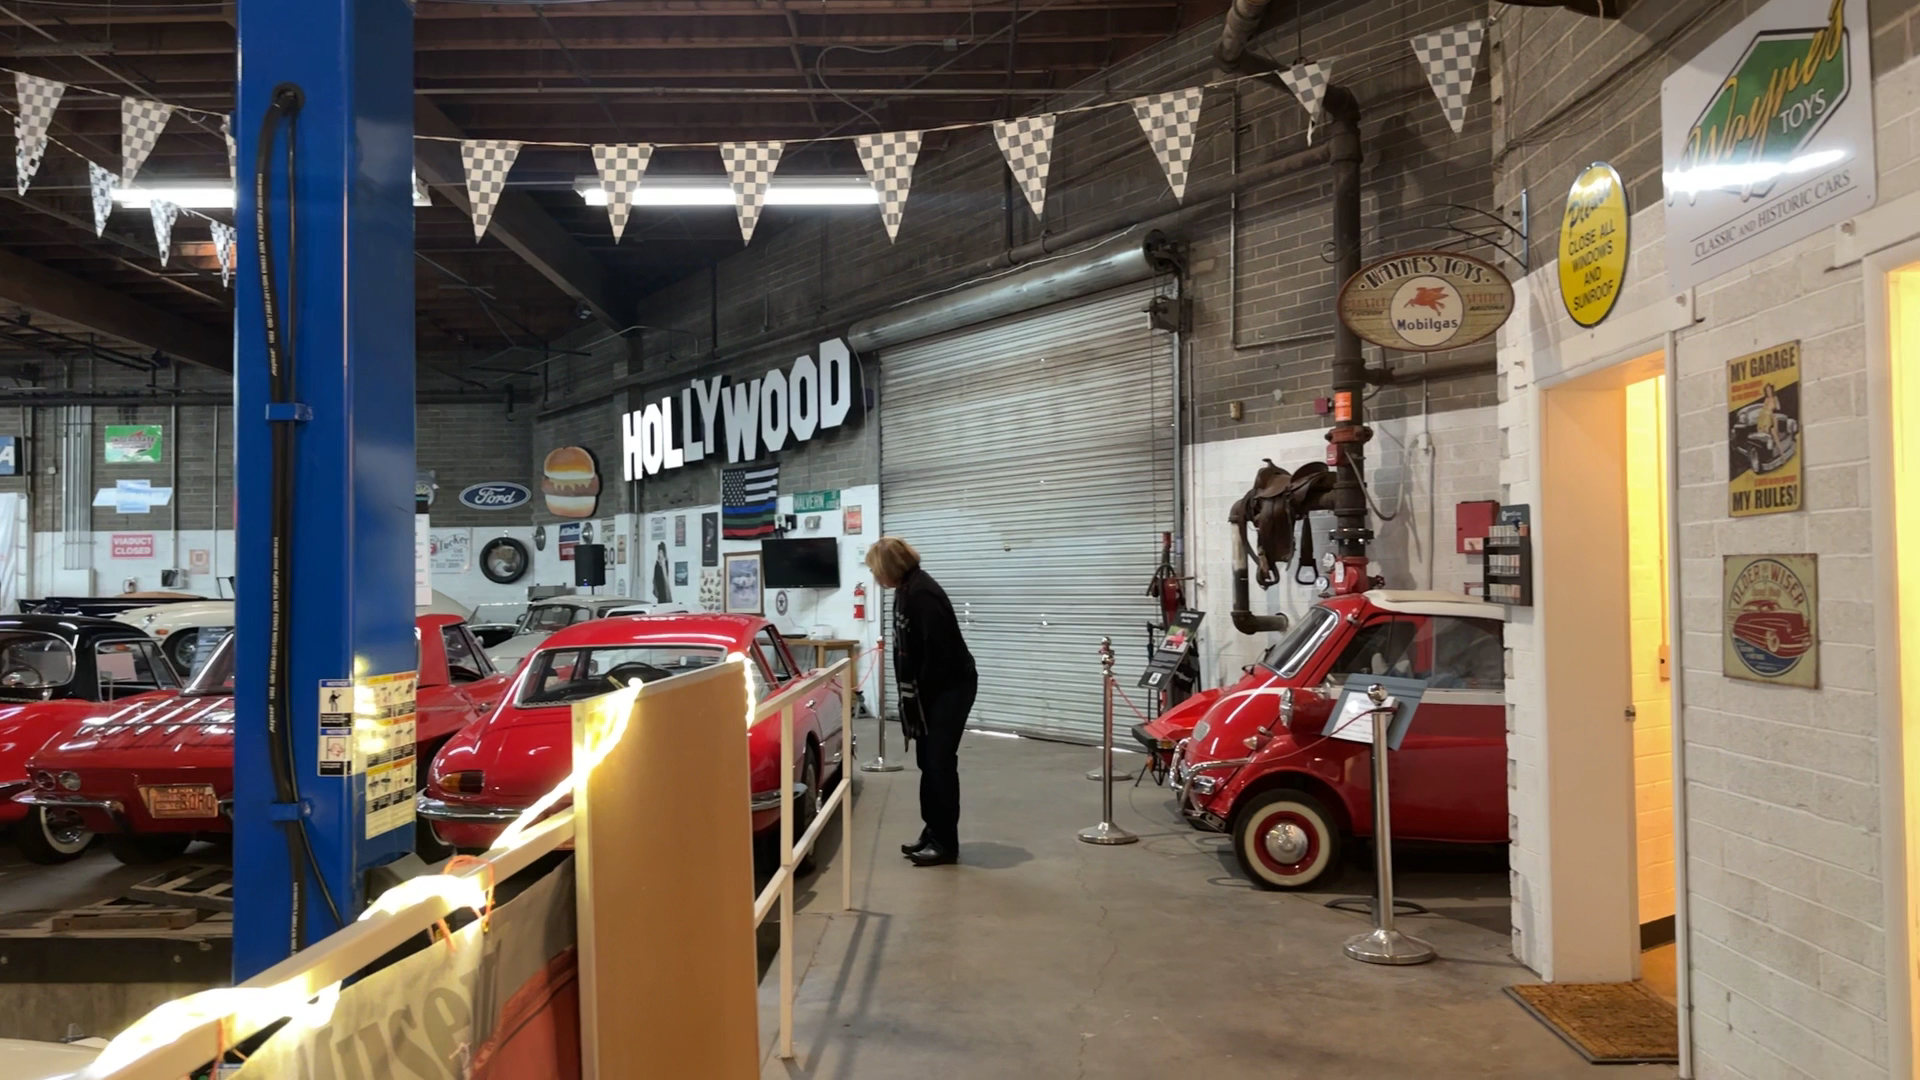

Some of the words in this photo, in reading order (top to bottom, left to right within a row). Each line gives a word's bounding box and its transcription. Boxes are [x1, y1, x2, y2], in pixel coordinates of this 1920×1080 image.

[1779, 88, 1826, 133] TOYS
[1694, 226, 1737, 257] CLASSIC
[1738, 220, 1757, 236] AND
[1757, 188, 1813, 228] HISTORIC
[1814, 169, 1851, 199] CARS
[1568, 228, 1596, 256] CLOSE
[1599, 219, 1616, 239] ALL
[1364, 256, 1438, 290] WAYNE'S
[1443, 257, 1484, 284] TOYS
[1572, 240, 1613, 273] WINDOWS
[1583, 266, 1601, 286] AND
[1573, 279, 1614, 311] SUNROOF
[1397, 317, 1458, 332] Mobilgas
[1731, 360, 1747, 383] MY
[1750, 346, 1796, 377] GARAGE
[622, 337, 851, 482] HOLLYWOOD
[474, 487, 516, 505] Ford
[1733, 490, 1751, 511] MY
[1755, 484, 1797, 509] RULES!
[113, 537, 152, 546] VIADUCT
[115, 547, 152, 555] CLOSED
[1732, 565, 1761, 605] OLDER
[1770, 563, 1805, 607] WISER
